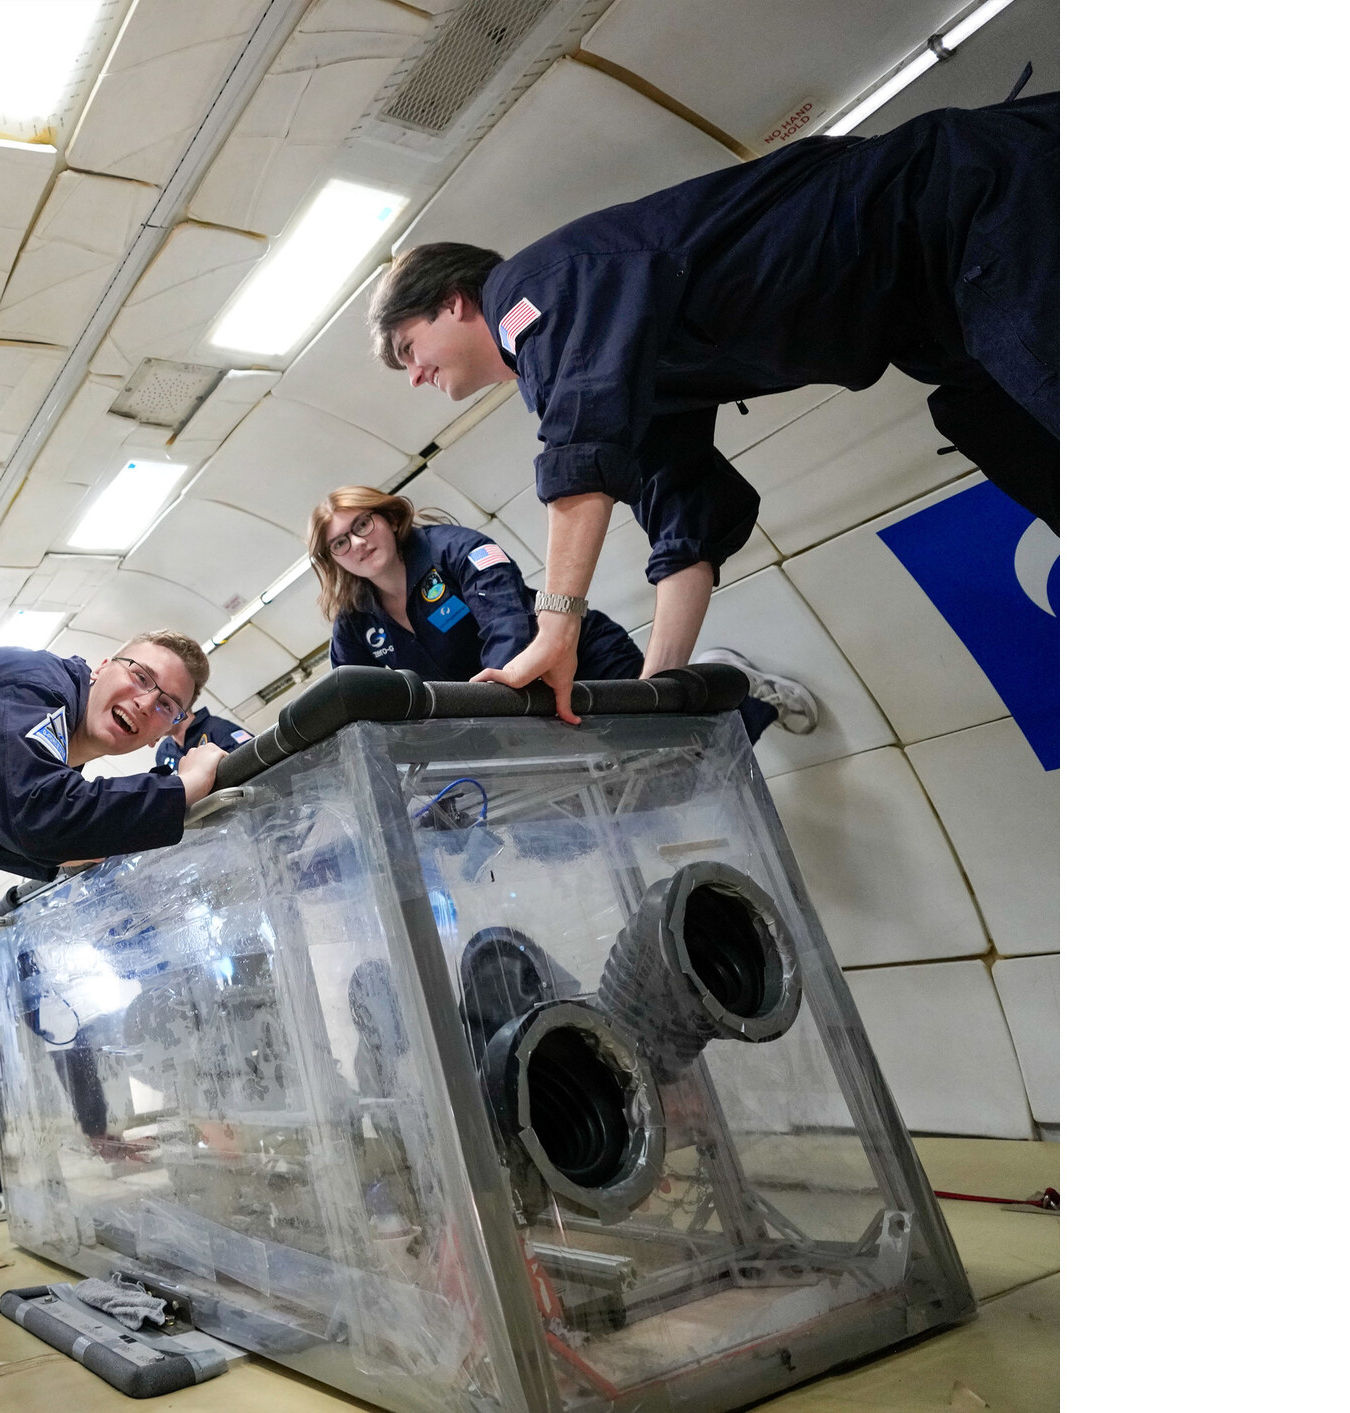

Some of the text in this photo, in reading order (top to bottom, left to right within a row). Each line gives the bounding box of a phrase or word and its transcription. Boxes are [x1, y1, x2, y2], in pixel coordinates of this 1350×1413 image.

[764, 103, 813, 144] NO HAND
[779, 115, 810, 141] HOLD
